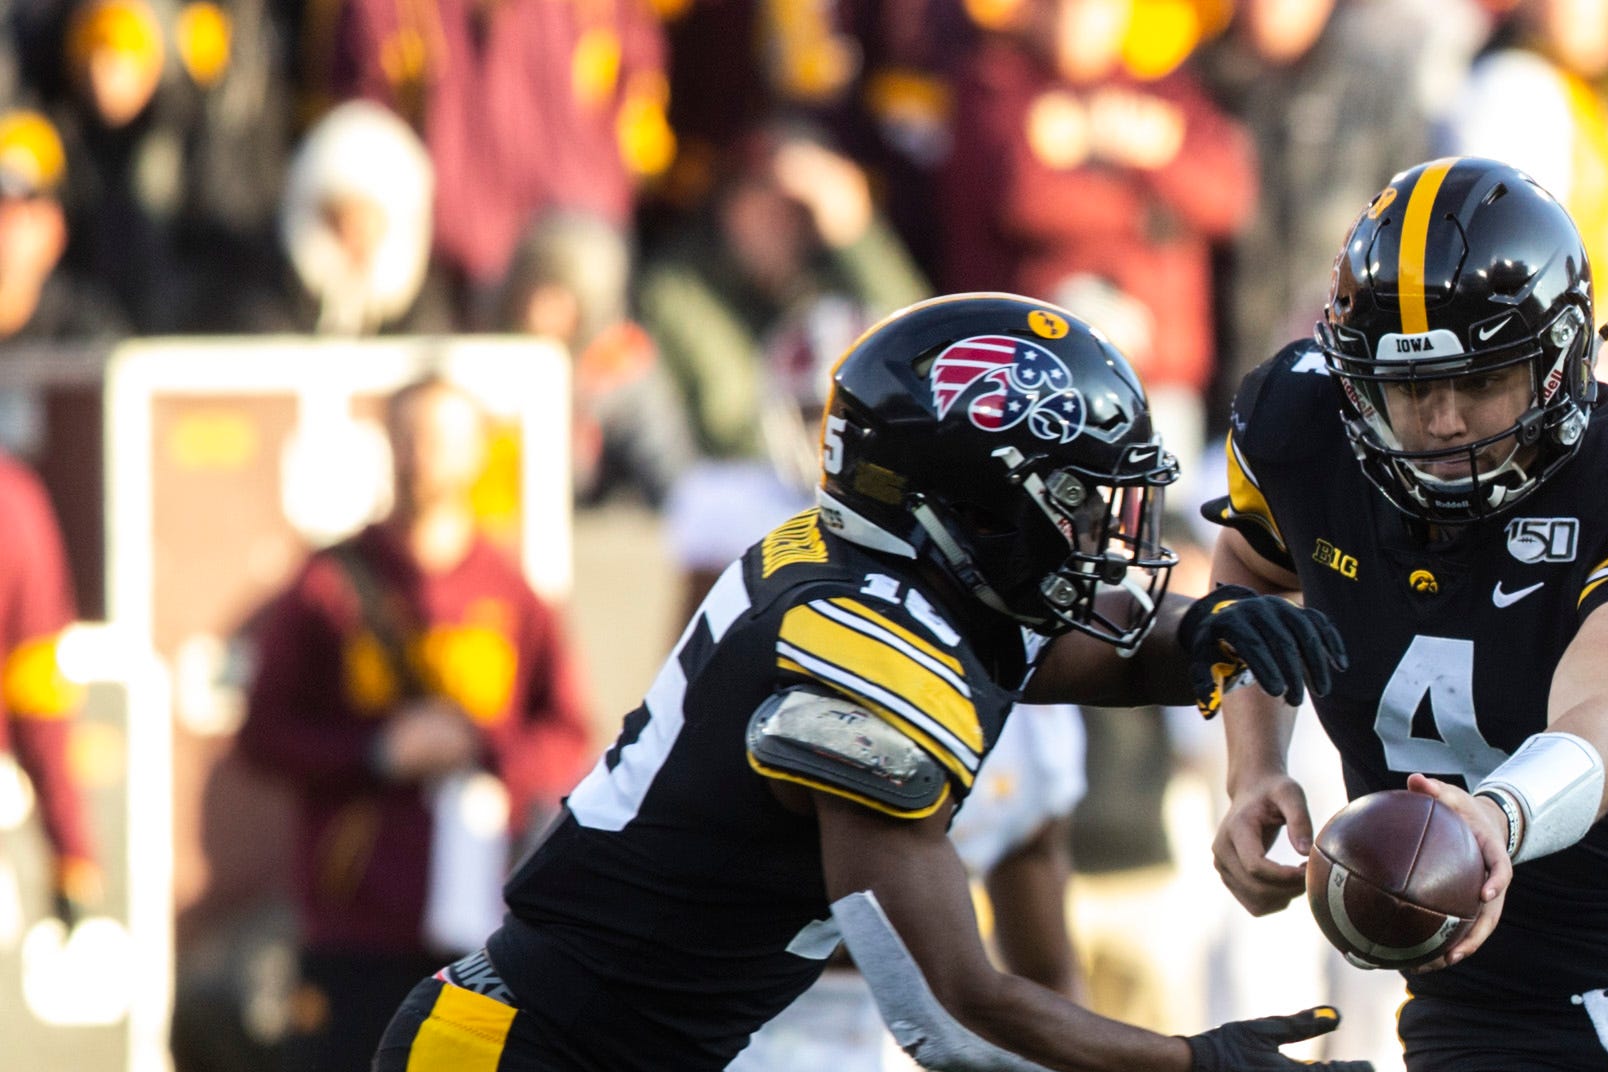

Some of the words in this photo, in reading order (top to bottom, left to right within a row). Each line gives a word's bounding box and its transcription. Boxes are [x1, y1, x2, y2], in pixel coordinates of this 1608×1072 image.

[1395, 336, 1434, 353] IOWA
[822, 414, 848, 475] 5
[1434, 500, 1470, 509] Riddell
[1503, 517, 1580, 564] 150
[1373, 633, 1511, 797] 4
